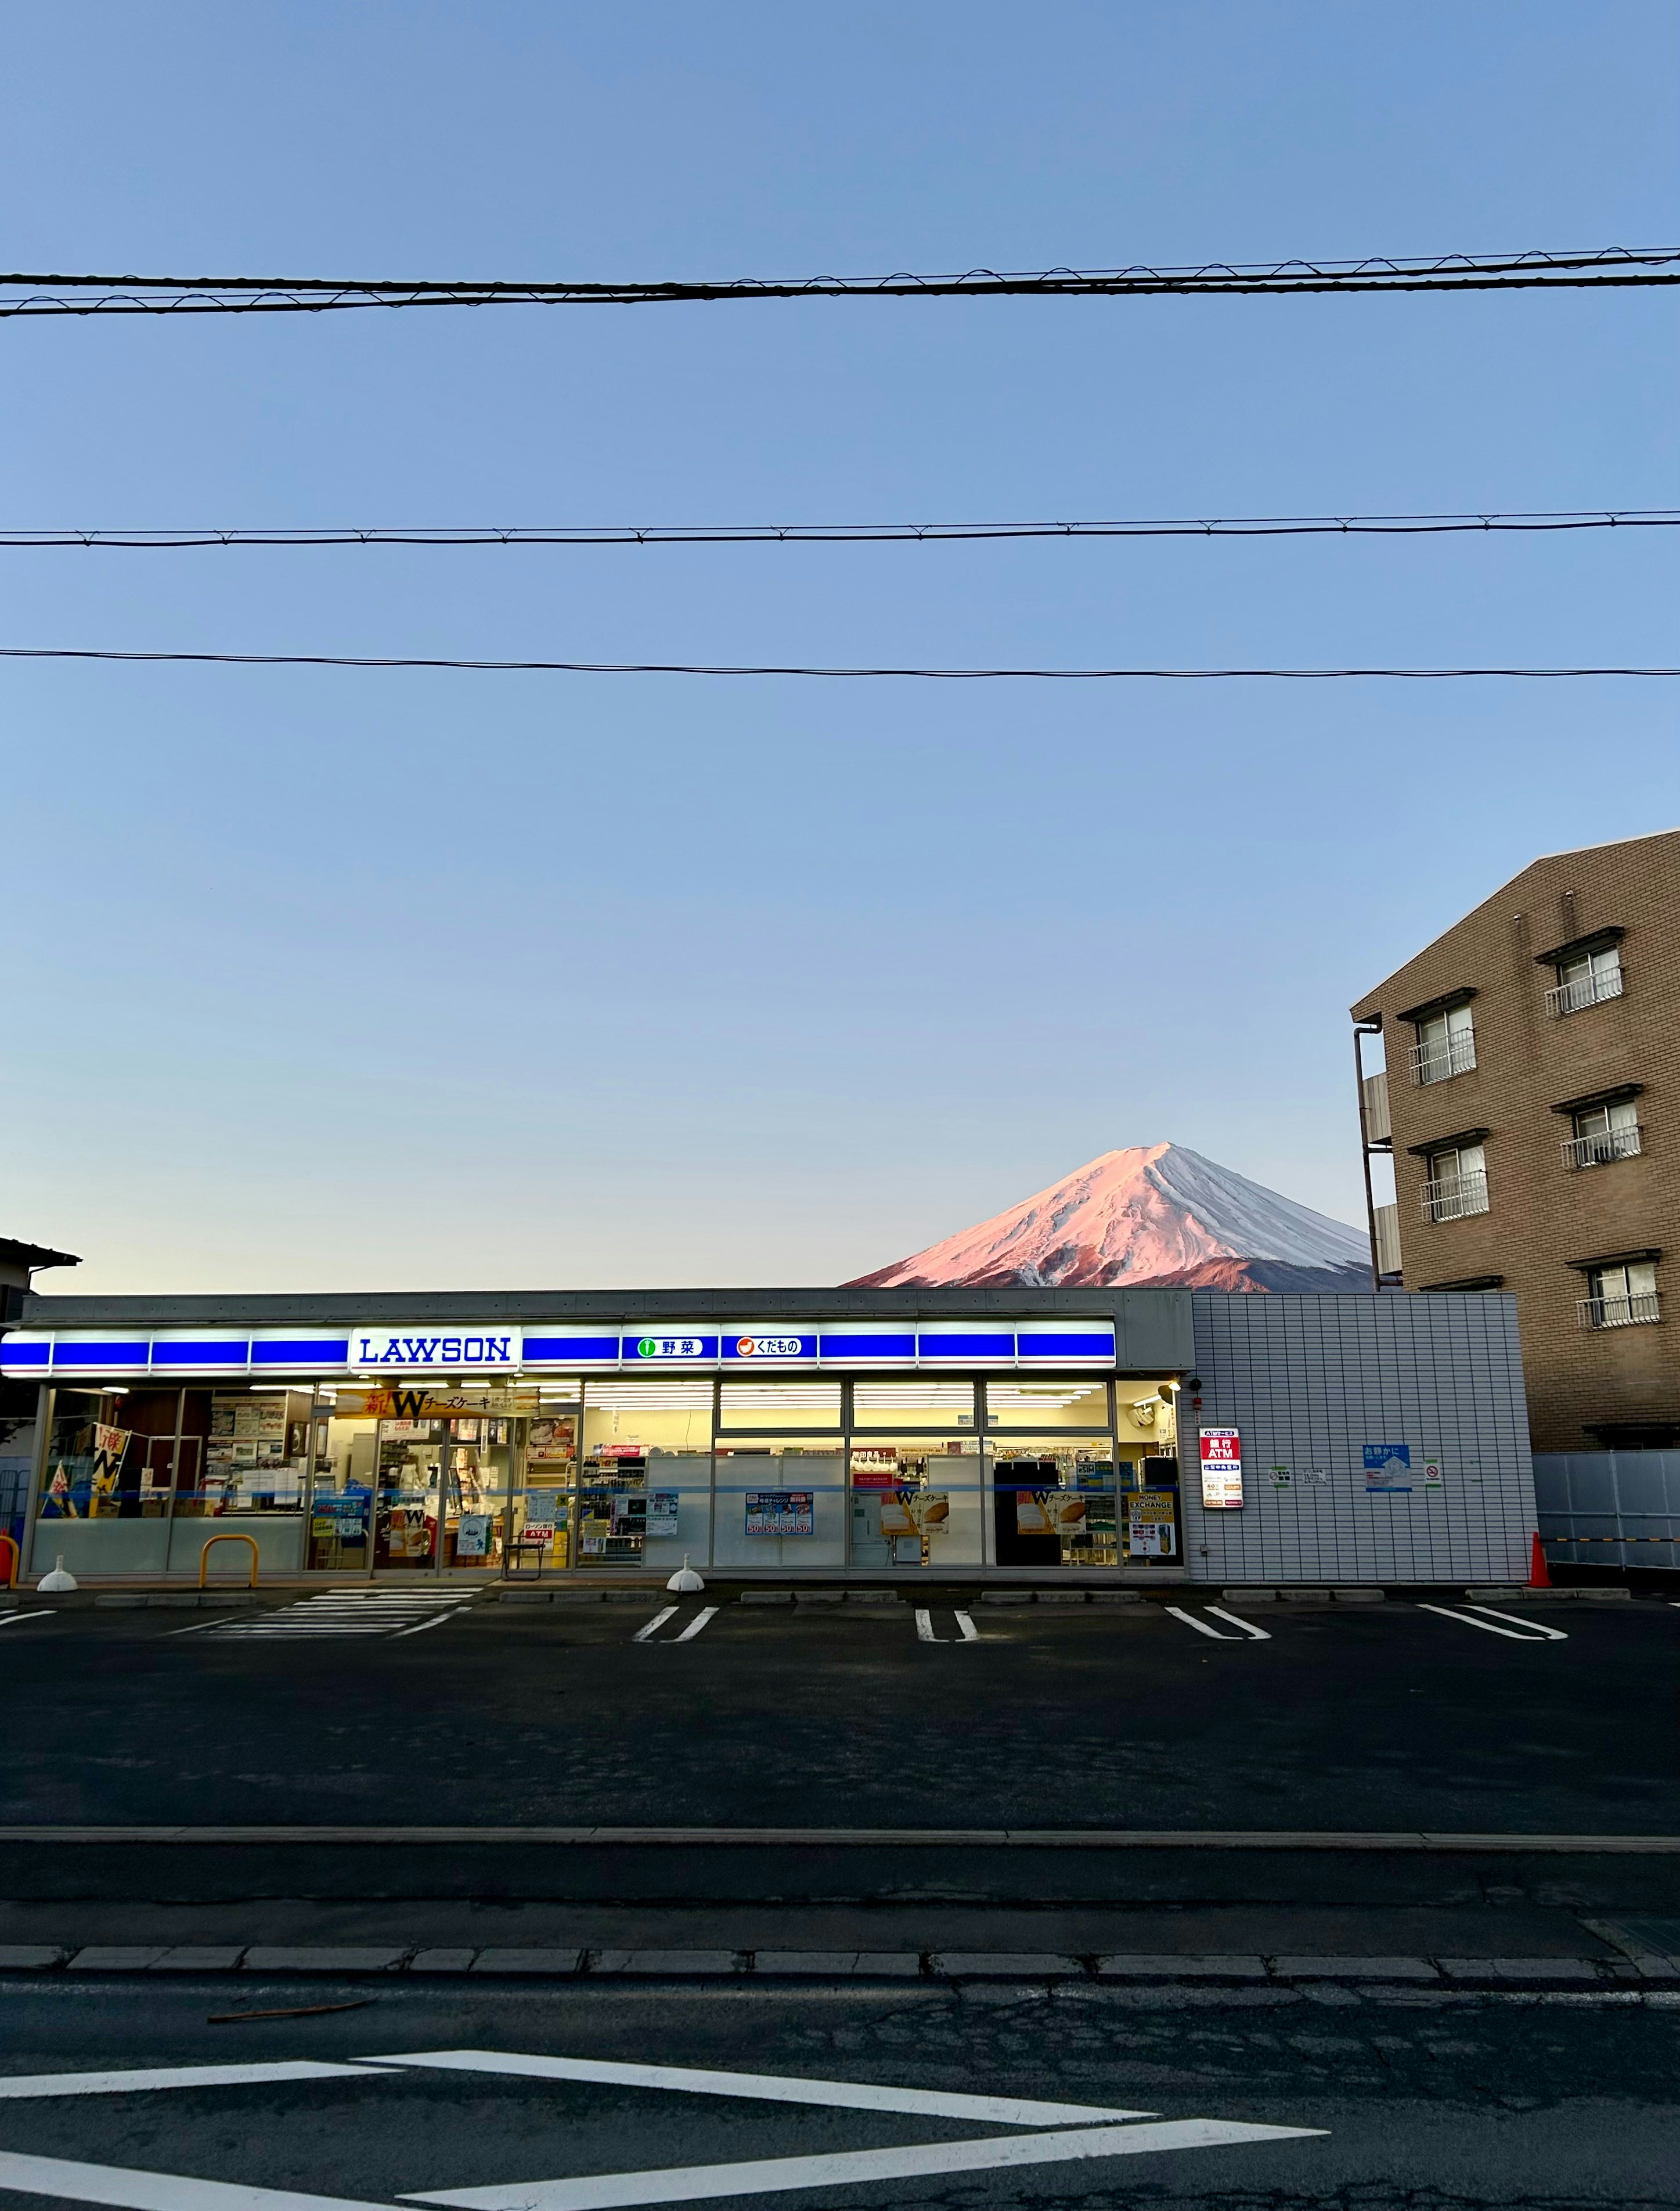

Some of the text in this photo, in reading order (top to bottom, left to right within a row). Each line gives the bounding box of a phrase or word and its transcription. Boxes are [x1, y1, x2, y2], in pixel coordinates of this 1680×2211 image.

[359, 1337, 511, 1362] LAWSON
[662, 1341, 694, 1354] 野菜
[757, 1339, 798, 1353] くだもの
[1209, 1439, 1231, 1449] 銀行
[1208, 1448, 1233, 1458] ATM
